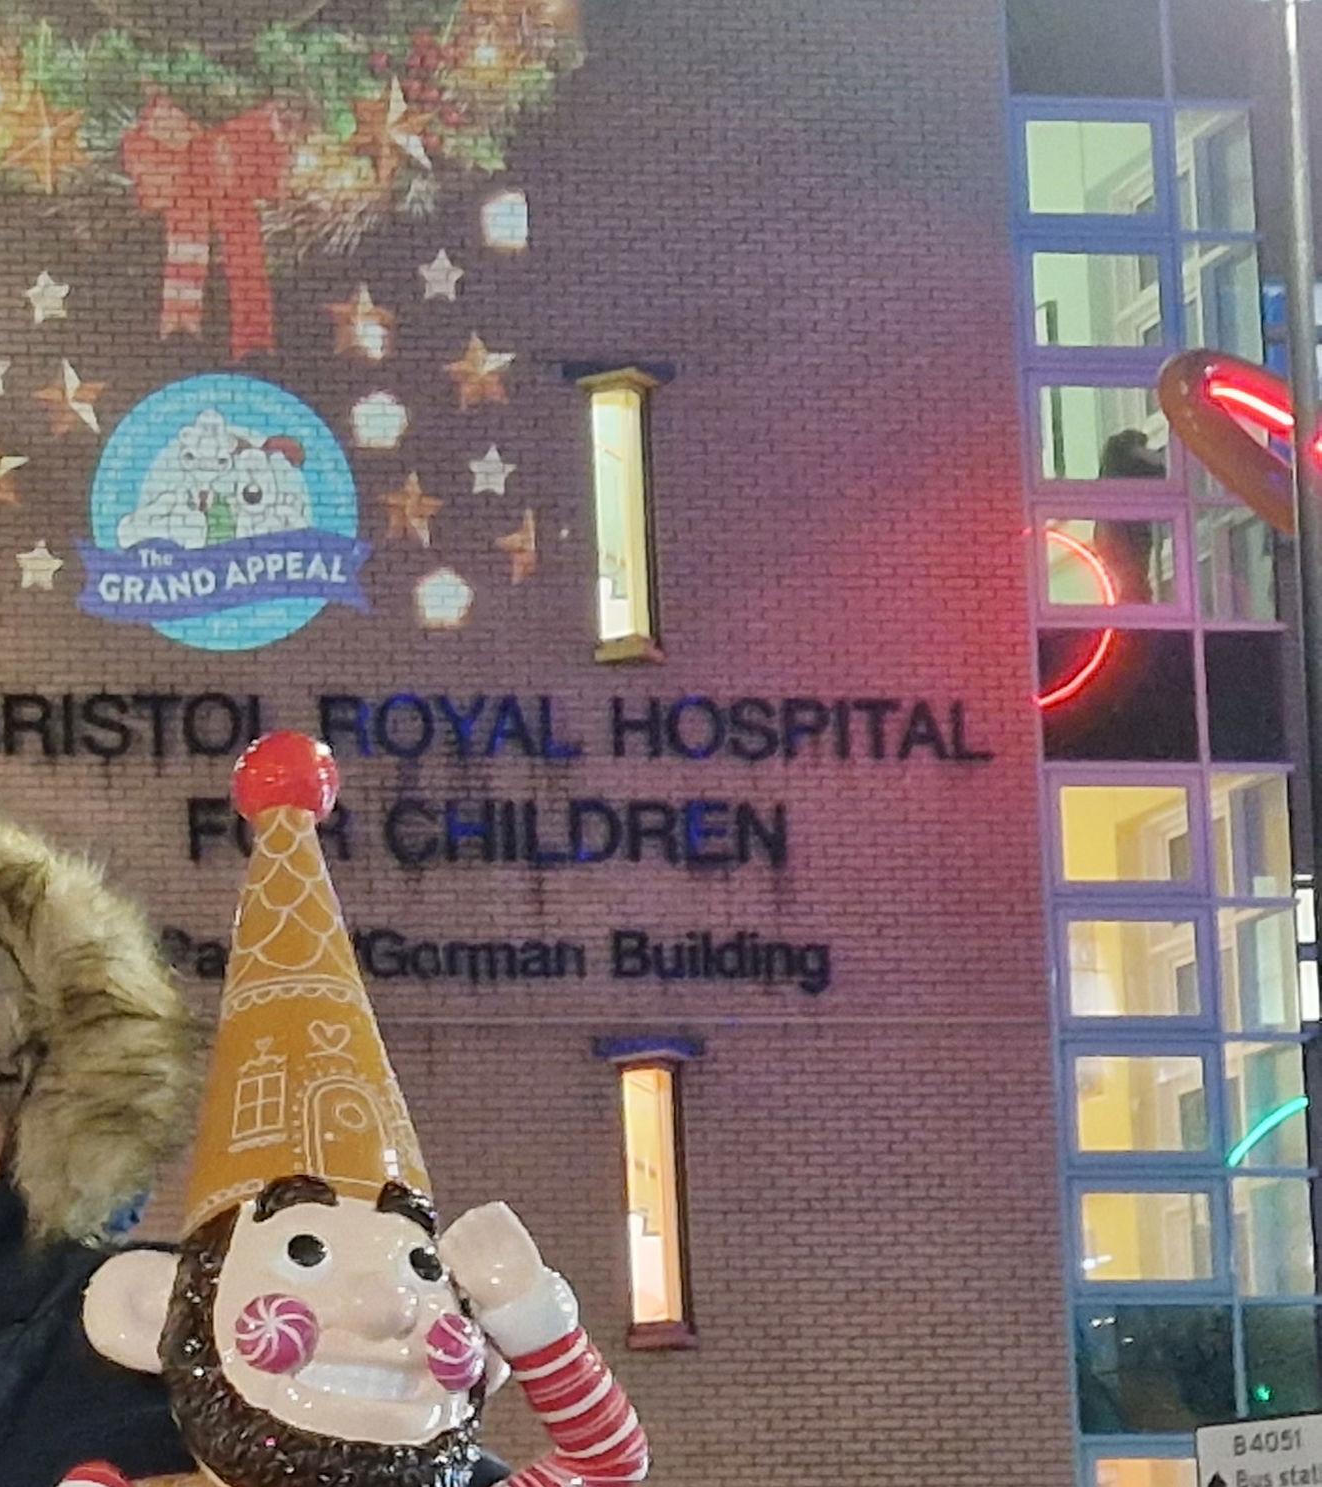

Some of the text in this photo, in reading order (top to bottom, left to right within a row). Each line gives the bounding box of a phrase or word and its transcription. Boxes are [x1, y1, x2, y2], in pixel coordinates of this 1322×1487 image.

[98, 552, 347, 604] GRAND APPEAL
[138, 549, 174, 568] The
[320, 693, 582, 758] ROYAL
[610, 695, 995, 761] HOSPITAL
[188, 797, 788, 869] FR CHILDREN
[611, 929, 832, 995] Building
